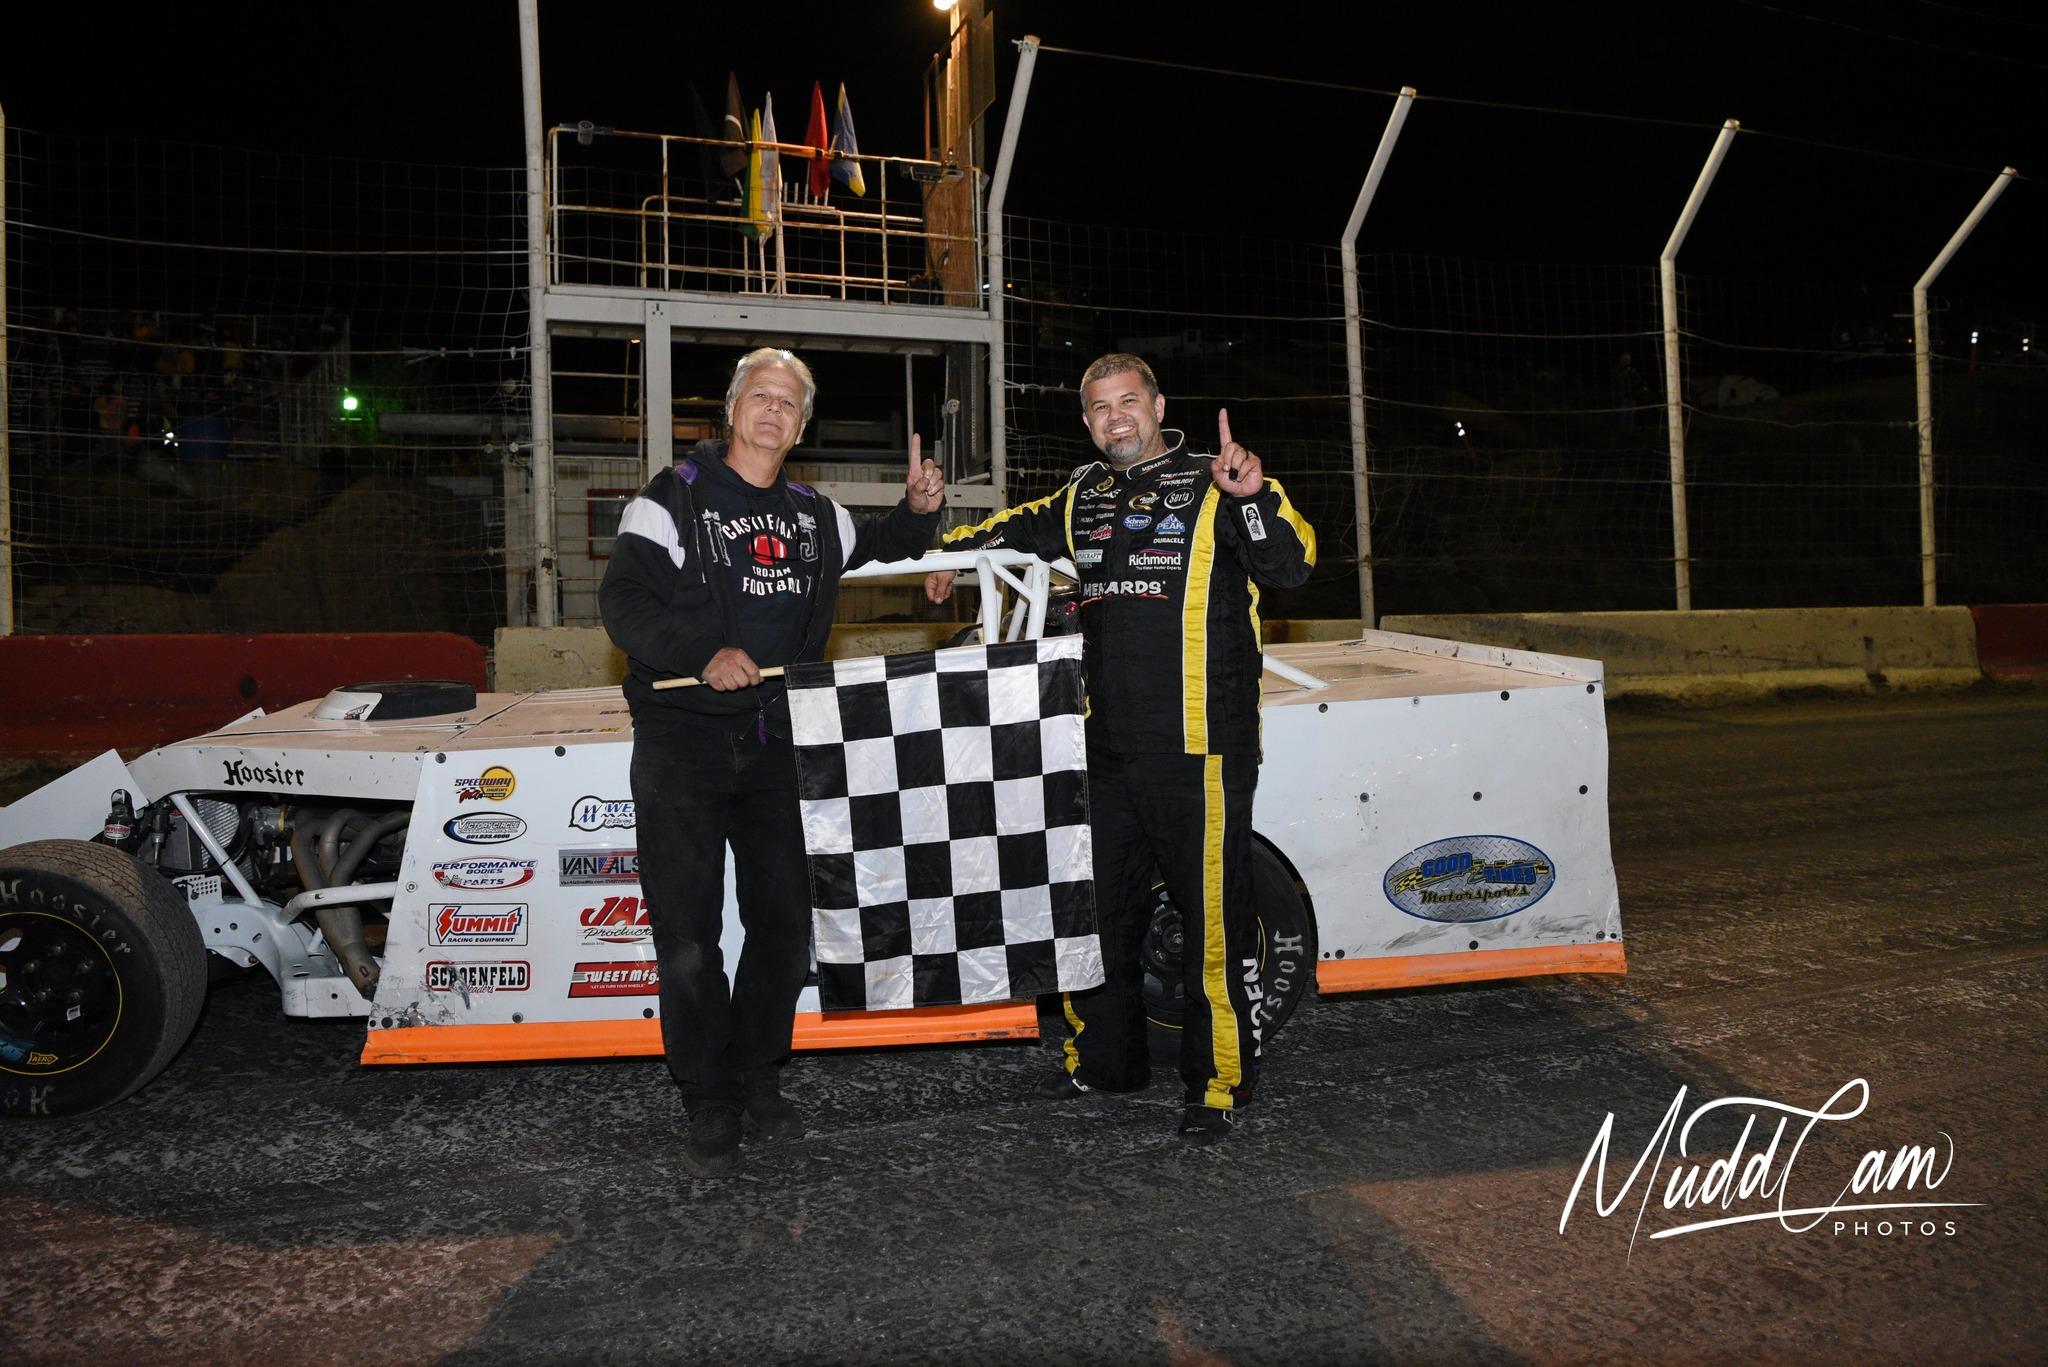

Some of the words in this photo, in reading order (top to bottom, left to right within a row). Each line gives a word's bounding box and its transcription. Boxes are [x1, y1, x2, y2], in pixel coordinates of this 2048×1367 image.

[1128, 552, 1182, 566] Richmond
[752, 565, 791, 578] TROJAN
[742, 577, 802, 596] FOOTBAL
[1083, 580, 1162, 597] MENARDS
[223, 759, 305, 786] Hoosier
[455, 778, 512, 787] SPEEDWAY
[432, 861, 536, 870] PERFORMANCE
[1422, 853, 1472, 878] GOOD
[463, 878, 505, 886] PARTS
[1419, 884, 1531, 904] Motorsports
[580, 896, 652, 926] JAZ
[438, 907, 519, 938] SUMMIT
[431, 966, 526, 987] SCHOENFELD
[582, 971, 629, 983] SWEET
[32, 1054, 52, 1063] AERO
